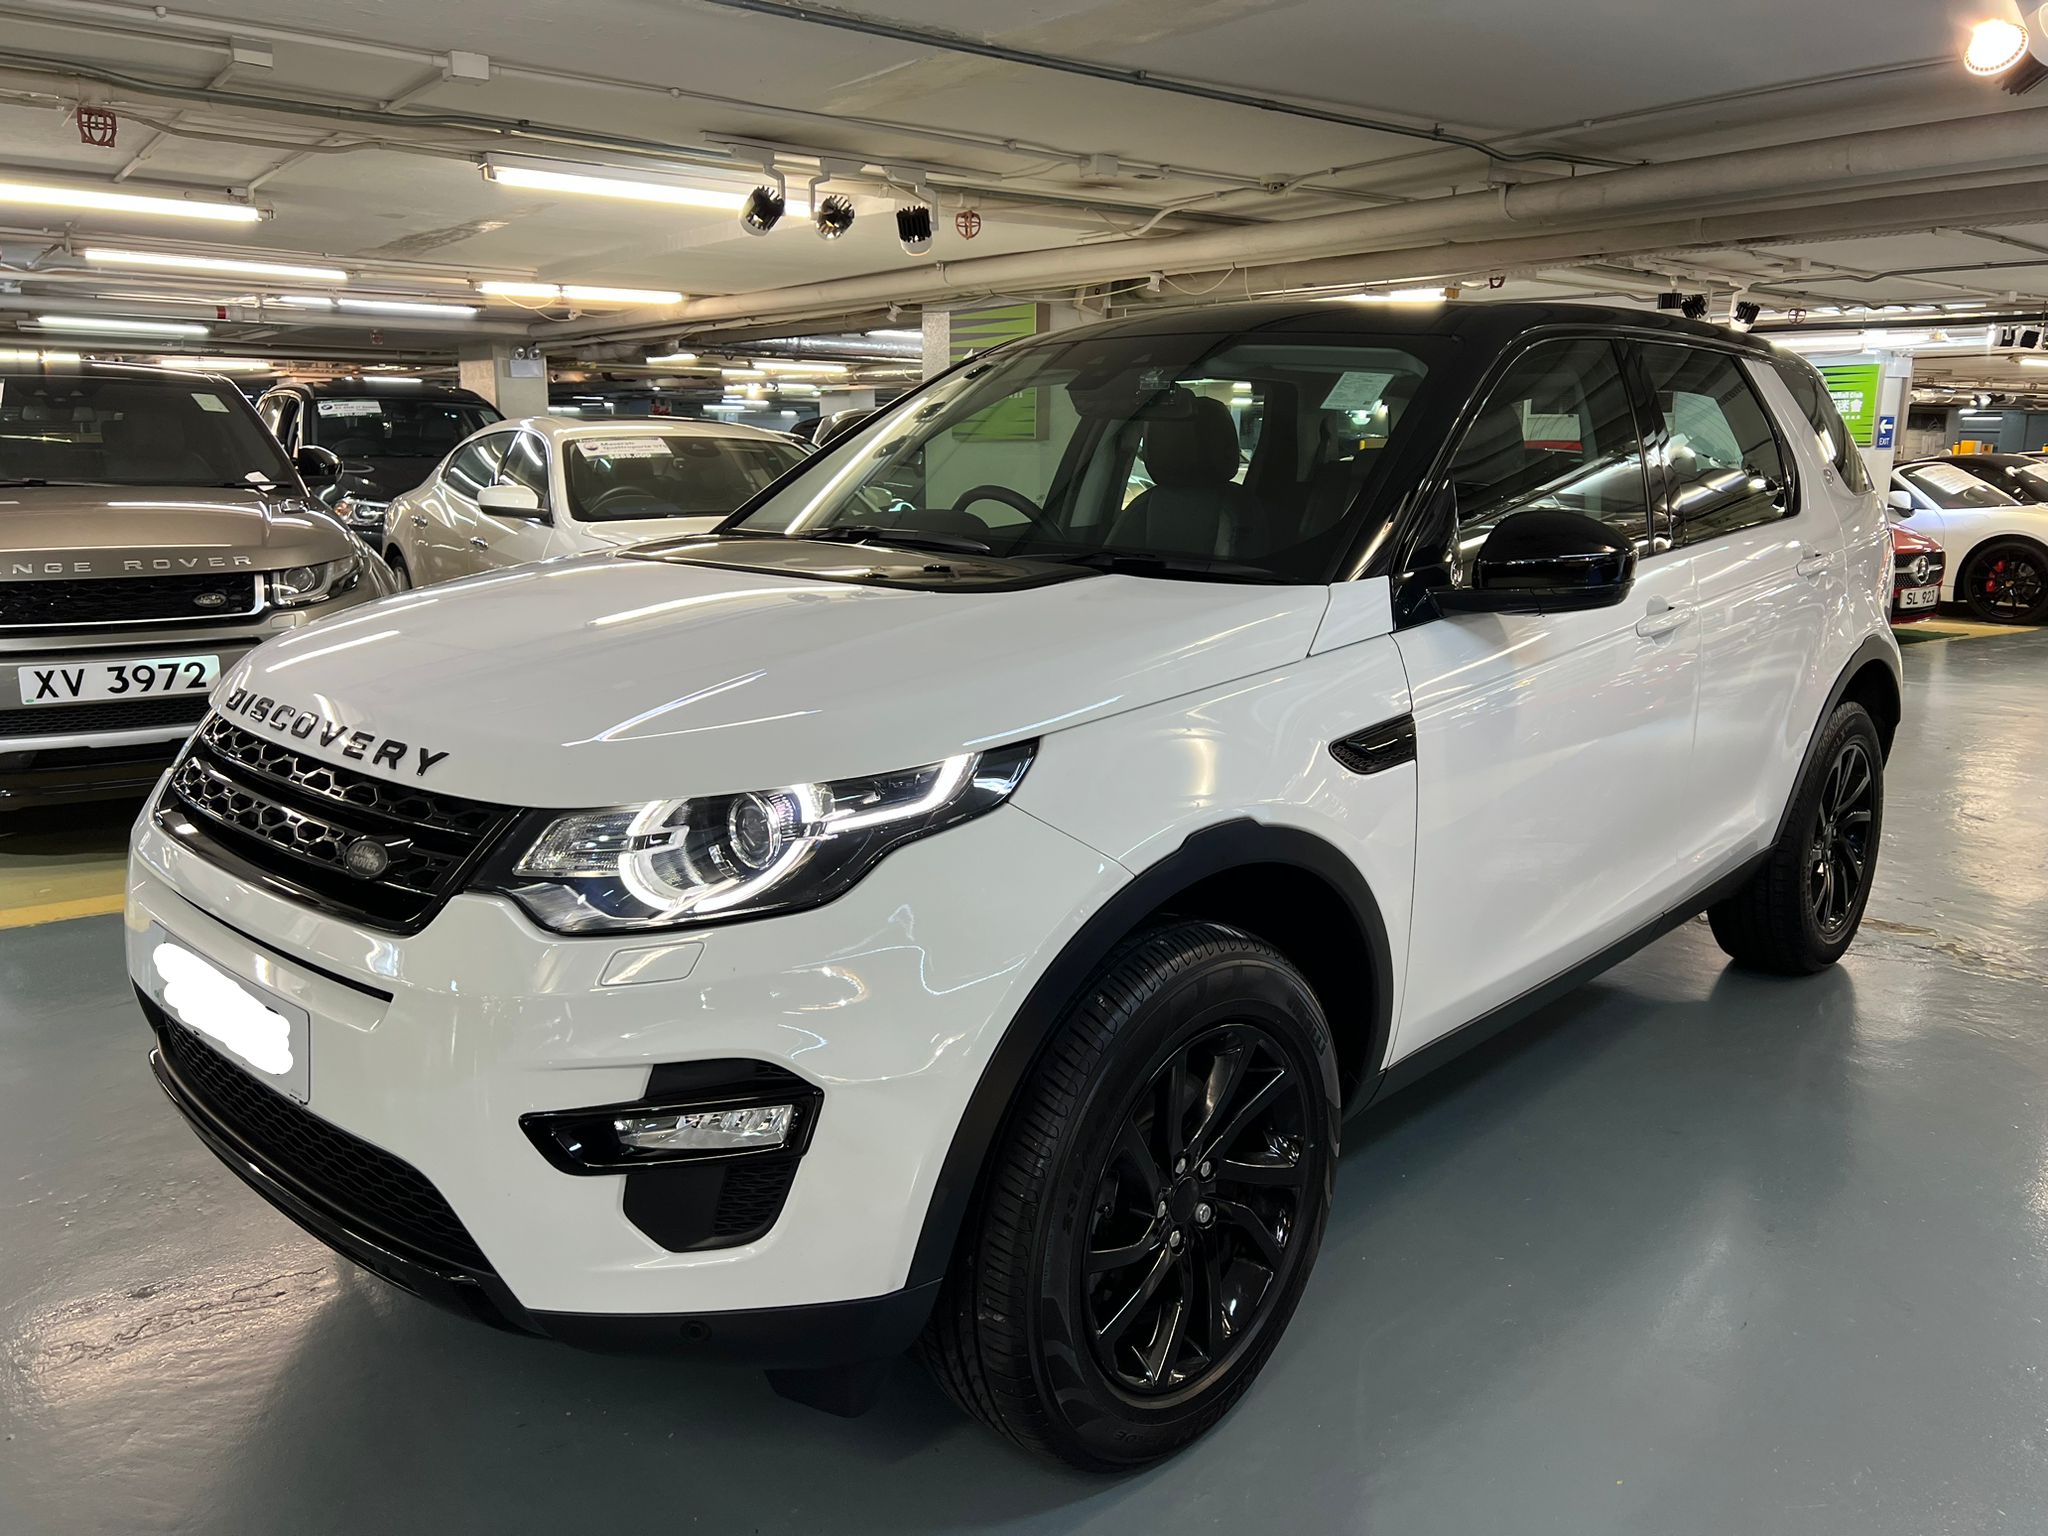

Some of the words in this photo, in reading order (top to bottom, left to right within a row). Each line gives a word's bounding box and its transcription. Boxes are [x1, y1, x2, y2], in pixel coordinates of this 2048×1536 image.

[1878, 436, 1890, 446] EXIT
[0, 562, 92, 575] NGE
[123, 555, 252, 571] ROVER
[1906, 591, 1918, 605] SL
[33, 668, 85, 699] XV
[107, 661, 208, 694] 3972
[225, 686, 451, 777] DISCOVERY
[352, 856, 379, 871] ROVER
